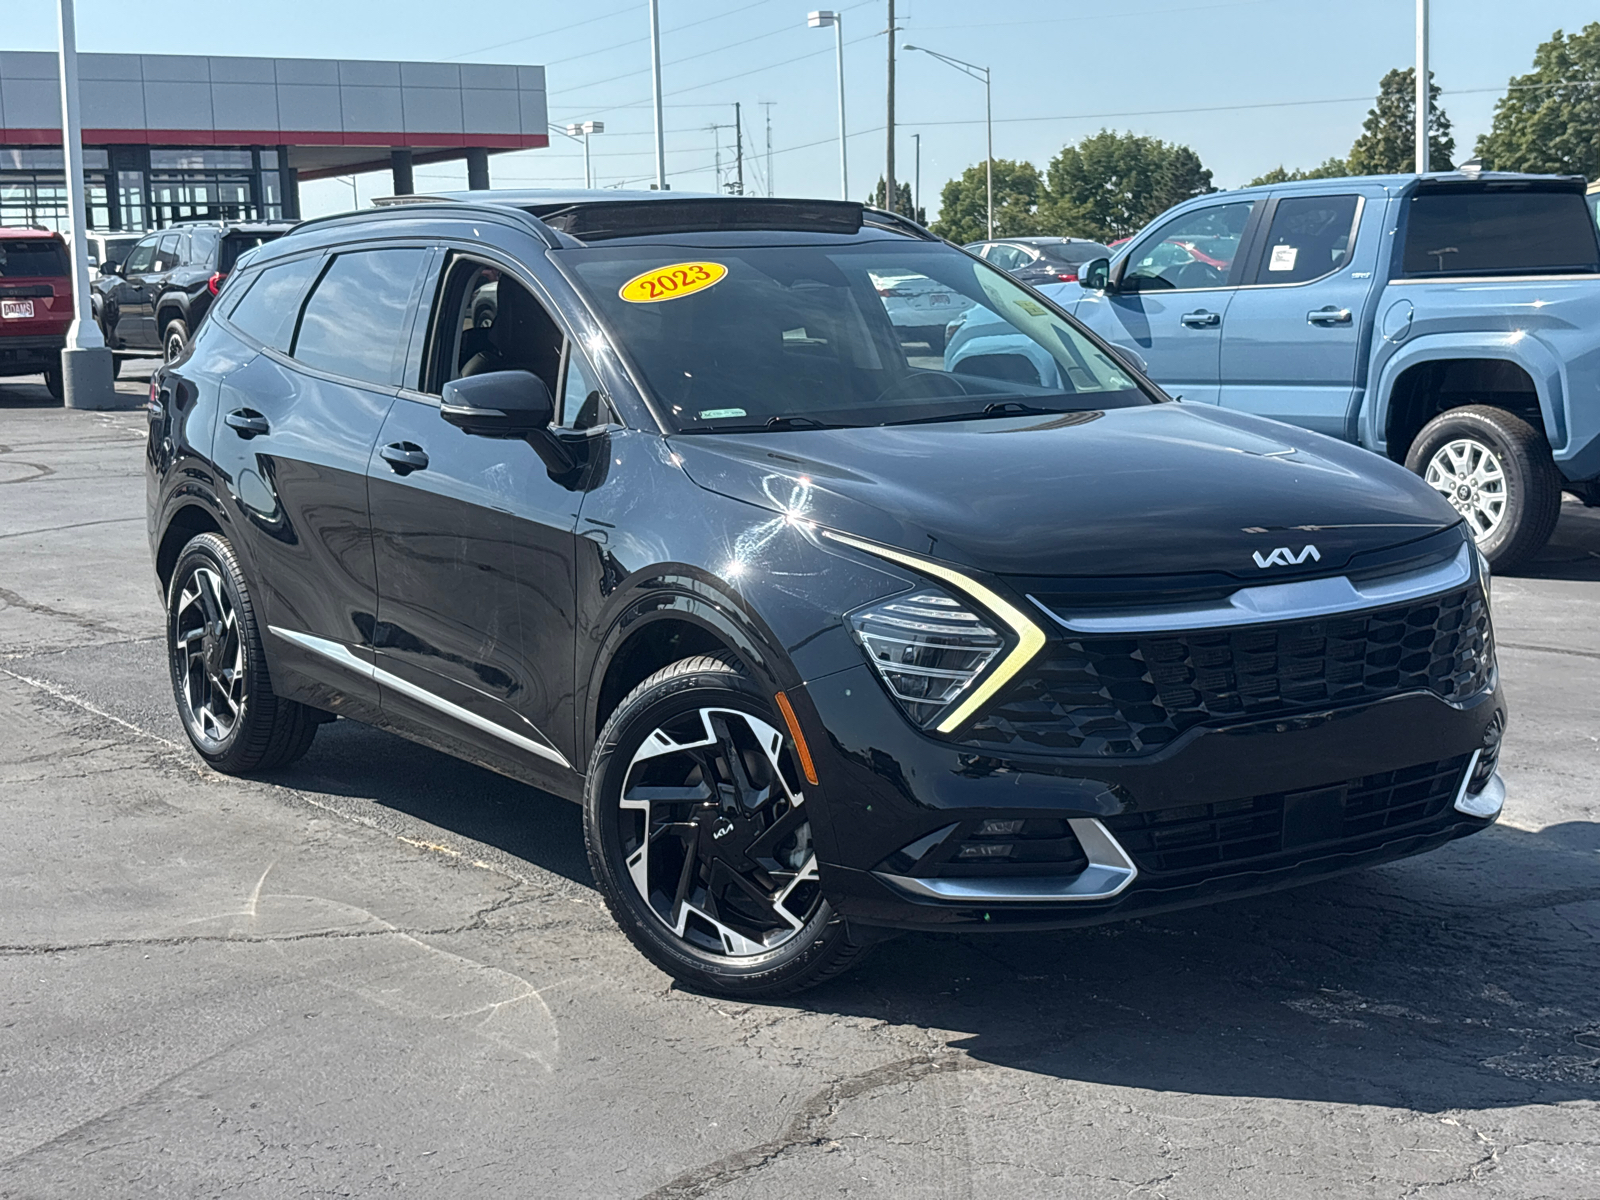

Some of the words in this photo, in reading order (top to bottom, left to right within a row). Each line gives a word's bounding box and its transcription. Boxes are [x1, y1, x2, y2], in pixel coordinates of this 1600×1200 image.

[640, 265, 711, 298] 2023
[4, 302, 33, 316] ADAMS
[1252, 544, 1321, 569] KIA
[713, 823, 735, 840] KIA
